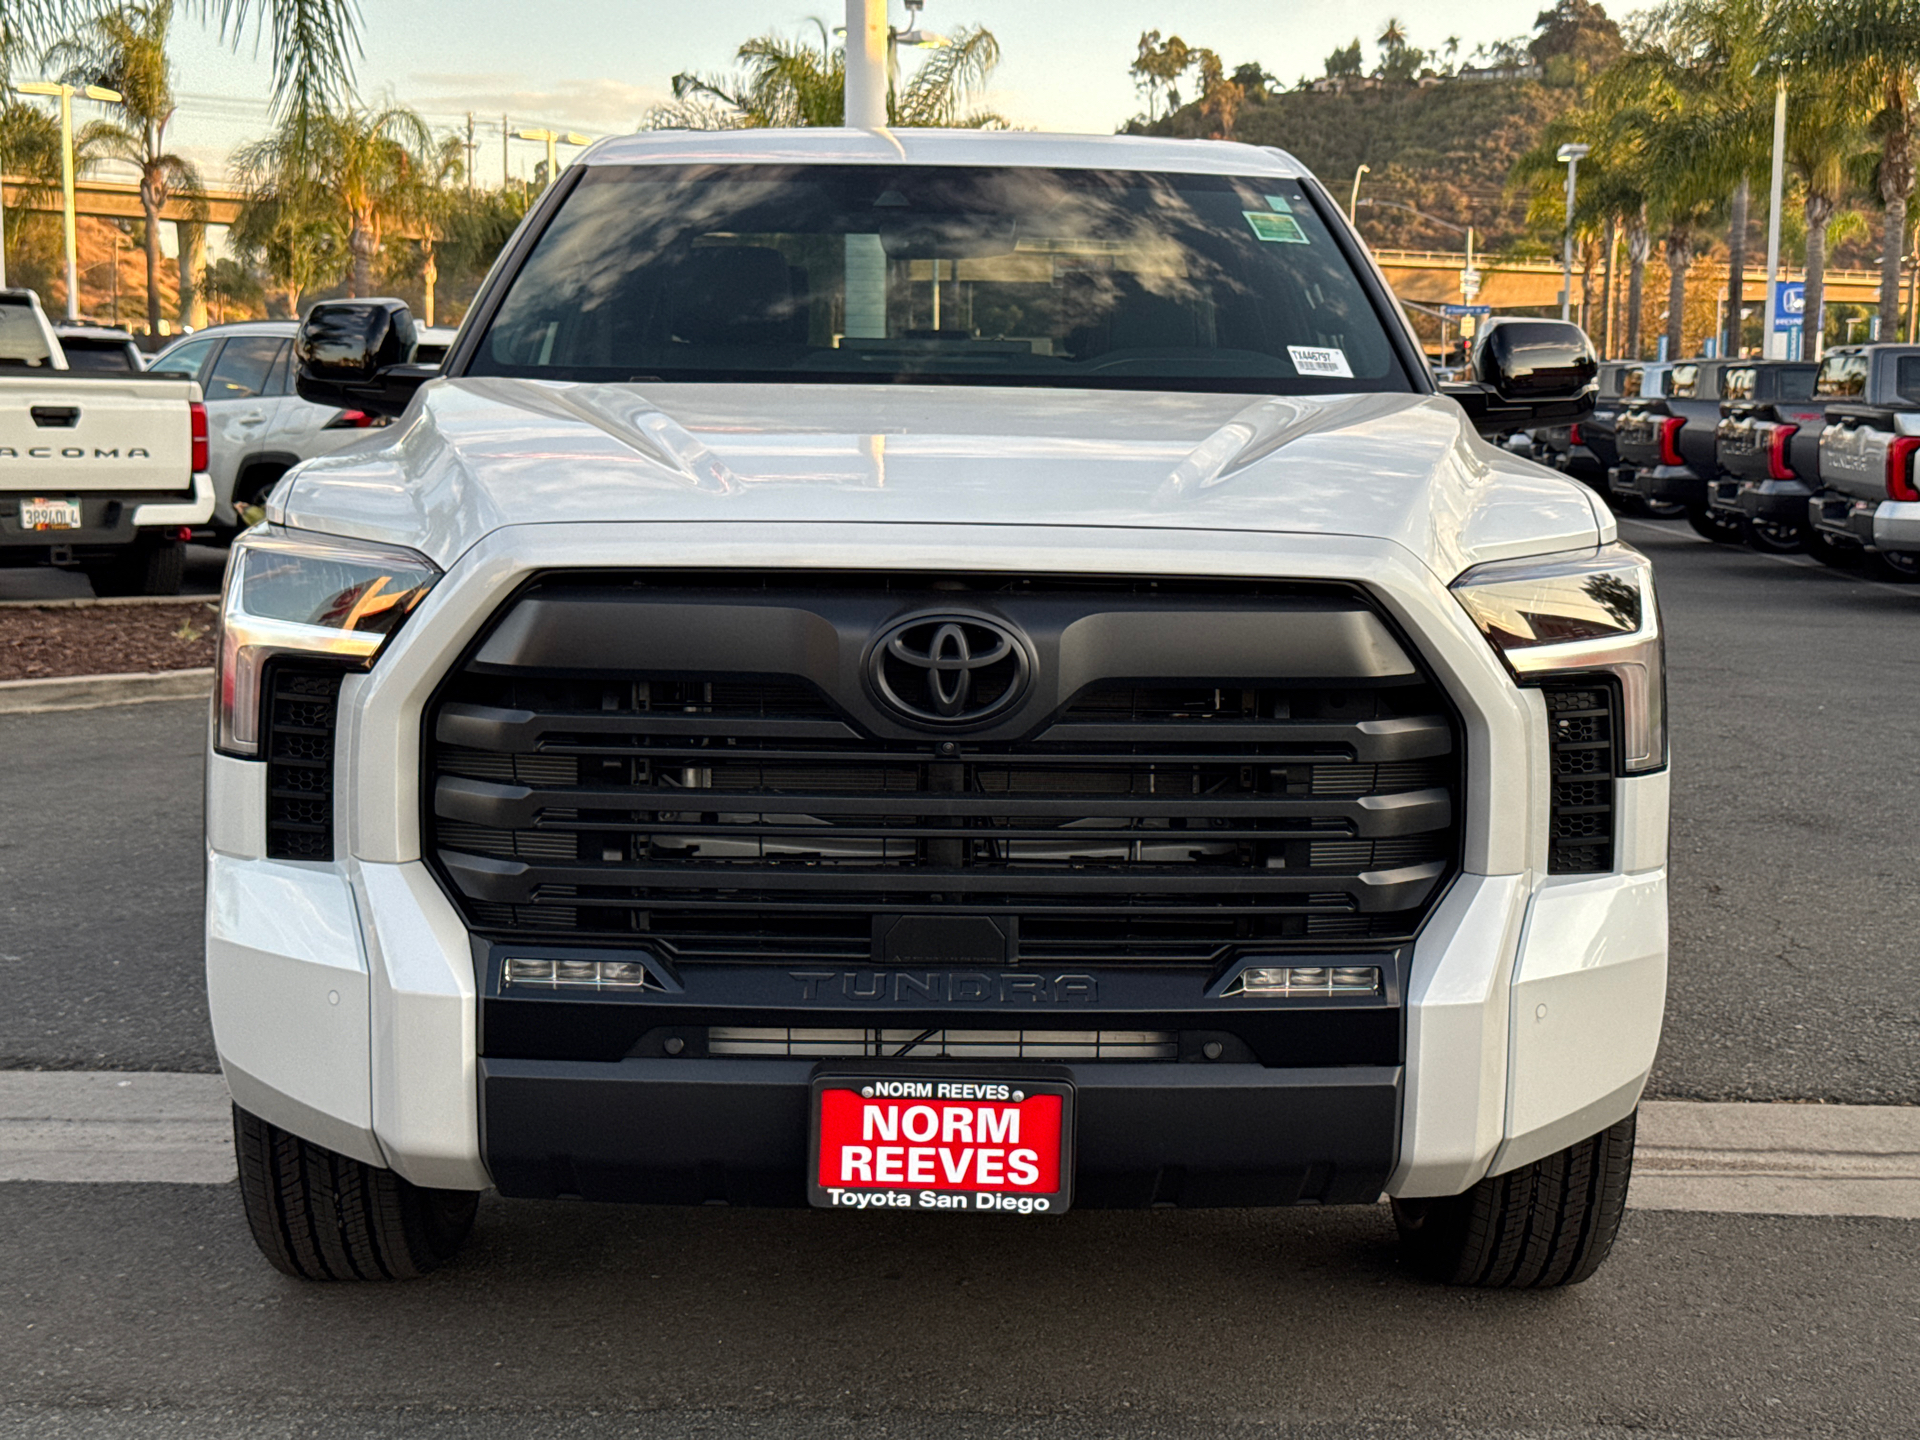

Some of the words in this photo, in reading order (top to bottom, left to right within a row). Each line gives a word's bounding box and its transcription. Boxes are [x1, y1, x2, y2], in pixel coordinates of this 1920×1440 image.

[1775, 317, 1804, 325] HON
[0, 447, 150, 458] ACOMA
[789, 971, 1099, 1003] TUNDRA
[875, 1081, 933, 1098] NORM
[937, 1083, 1010, 1100] REEVES
[862, 1104, 1021, 1144] NORM
[840, 1145, 1040, 1186] REEVES
[827, 1188, 912, 1209] Toyota
[919, 1191, 968, 1209] San
[975, 1192, 1051, 1214] Diego
